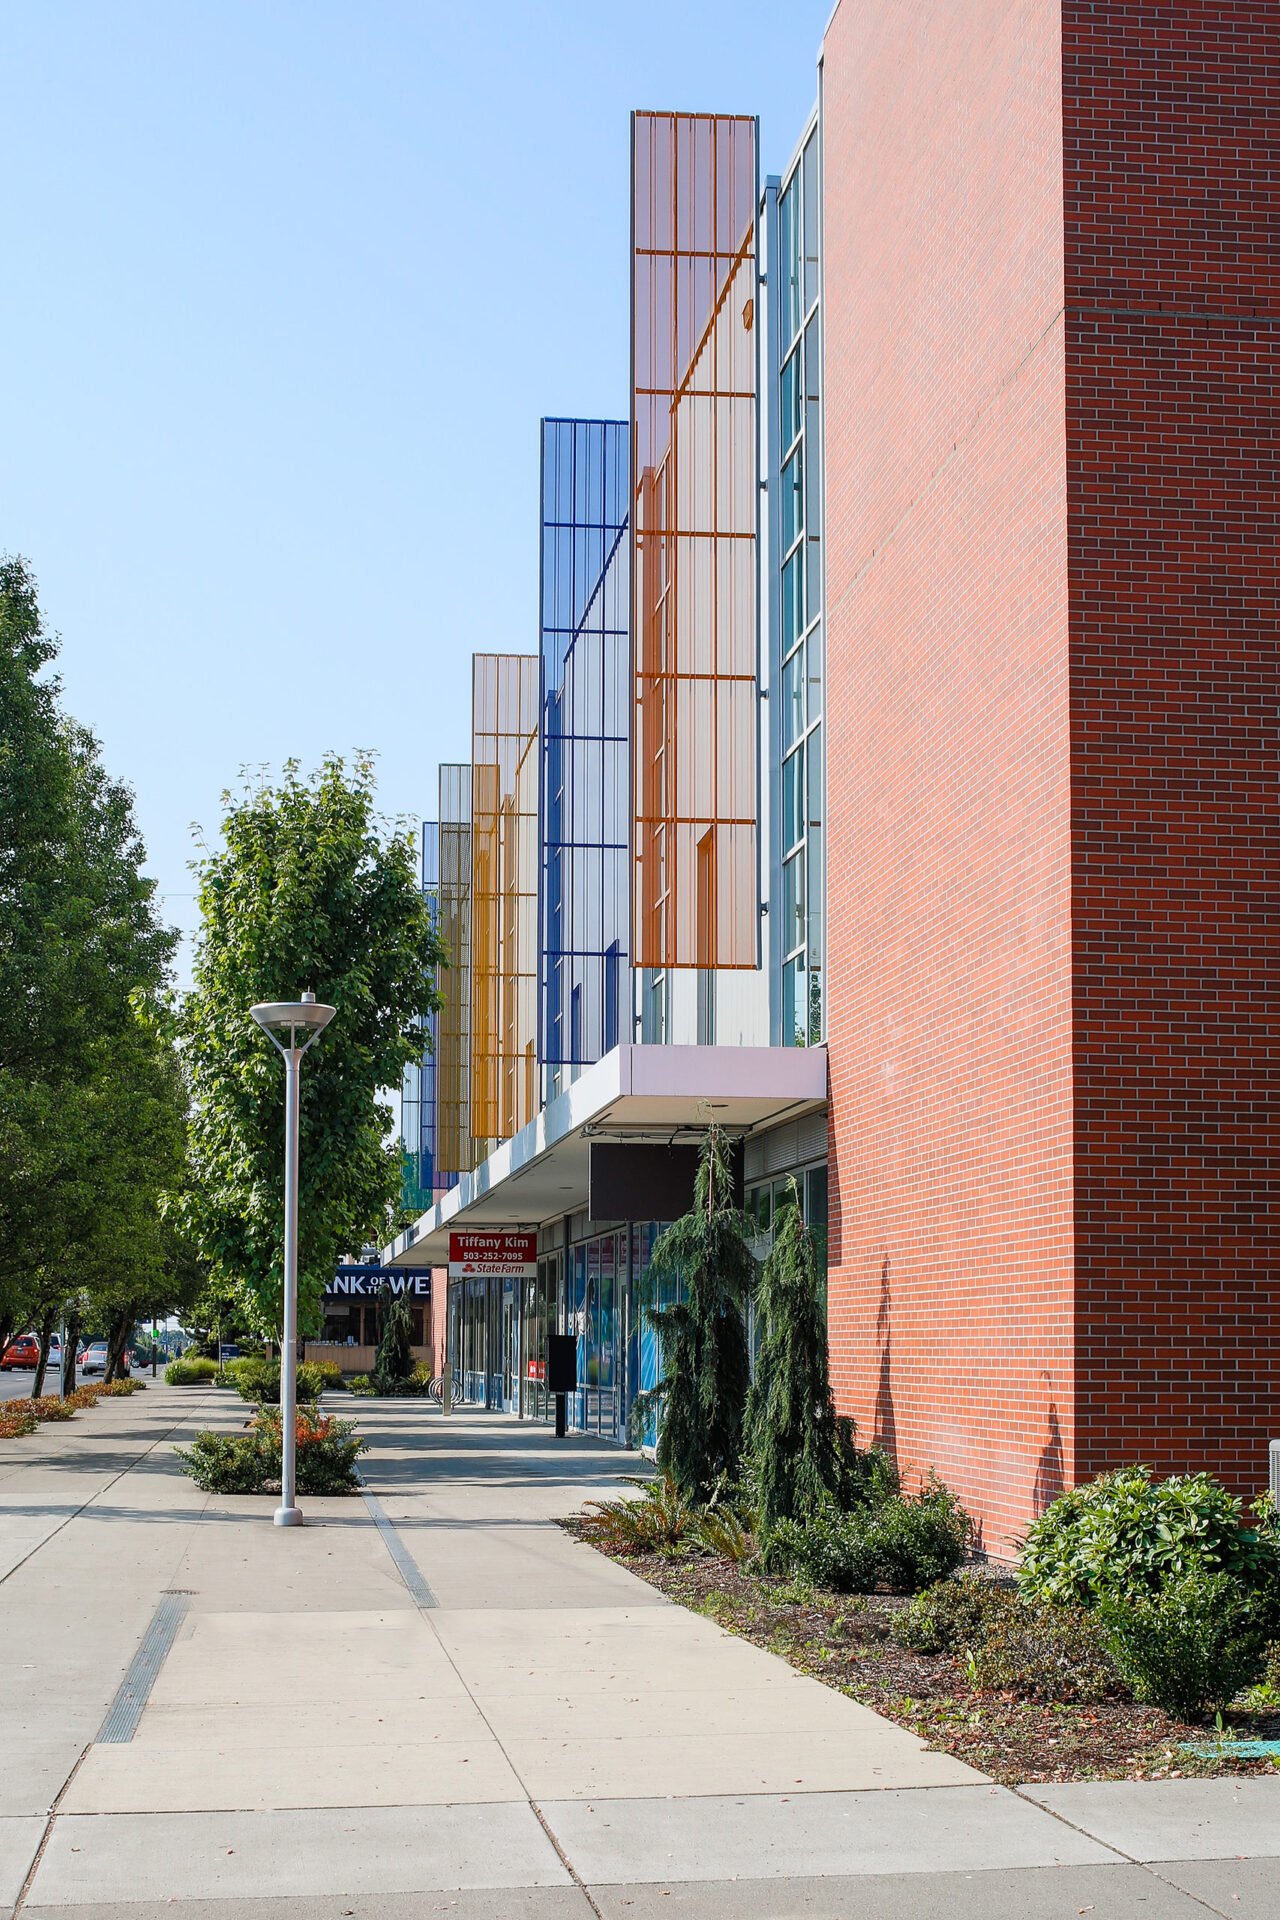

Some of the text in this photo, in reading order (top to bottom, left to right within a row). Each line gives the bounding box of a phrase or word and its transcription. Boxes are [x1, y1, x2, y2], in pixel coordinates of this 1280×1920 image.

[457, 1236, 529, 1249] Tiffany Kim
[463, 1252, 523, 1260] 503-252-7095
[370, 1277, 386, 1286] OF
